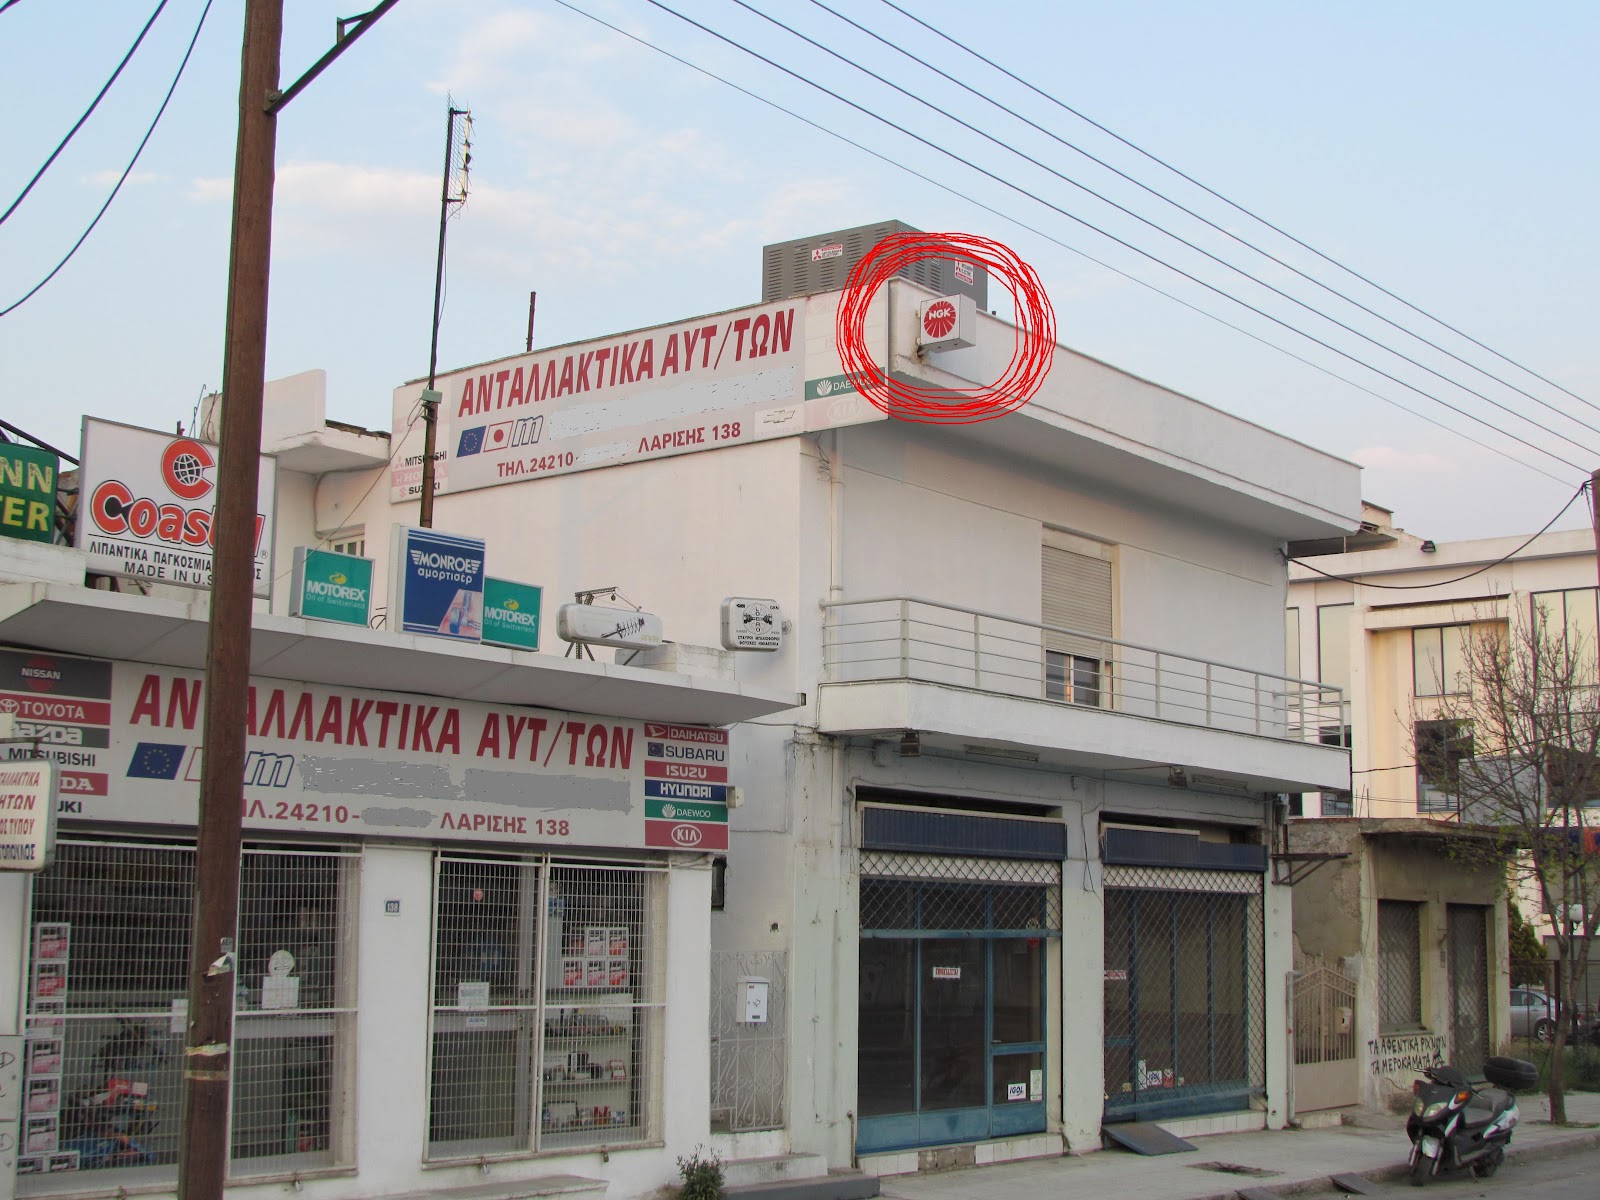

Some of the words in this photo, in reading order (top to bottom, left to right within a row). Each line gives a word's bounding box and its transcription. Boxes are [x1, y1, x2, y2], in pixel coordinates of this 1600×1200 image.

[929, 309, 951, 320] NGK
[458, 339, 654, 417] ΑΝΤΑΛΛΑΚΤΙΚΑ
[660, 308, 795, 376] ΑΥΤ/ΤΩΝ
[638, 427, 706, 454] ΛΑΡΙΣΗΣ
[712, 422, 741, 441] 138
[0, 494, 49, 531] ER
[90, 479, 265, 565] Coas
[89, 541, 148, 562] ΛΙΠΑΝΤΙΚΑ
[154, 551, 213, 572] ΠΑΓΚΟΣΜΙΑ
[418, 552, 474, 575] MONROE
[124, 561, 165, 578] MADE
[174, 569, 188, 582] IN
[193, 574, 213, 586] U.S
[417, 567, 473, 585] αμορτισέρ
[306, 580, 365, 602] MOTOREX
[484, 606, 536, 627] MOTOREX
[21, 667, 61, 680] NISSAN
[21, 701, 85, 719] TOYOTA
[129, 674, 461, 755] ΑΝΛΛΑΚΤΙΚΑ
[476, 712, 634, 769] ΑΥΤ/ΤΩΝ
[669, 725, 724, 743] DAIHATSU
[665, 745, 725, 762] SUBARU
[665, 764, 707, 779] ISUZU
[660, 782, 712, 799] HYUNDAI
[676, 808, 711, 819] DAEWOO
[9, 819, 35, 835] ΤΥΠΟΥ
[440, 812, 527, 834] ΛΑΡΙΣΗΣ
[535, 819, 570, 837] 138
[676, 828, 698, 842] KIA
[387, 903, 399, 912] 138
[1368, 1039, 1379, 1054] ΤΑ
[1371, 1060, 1380, 1075] ΤΑ
